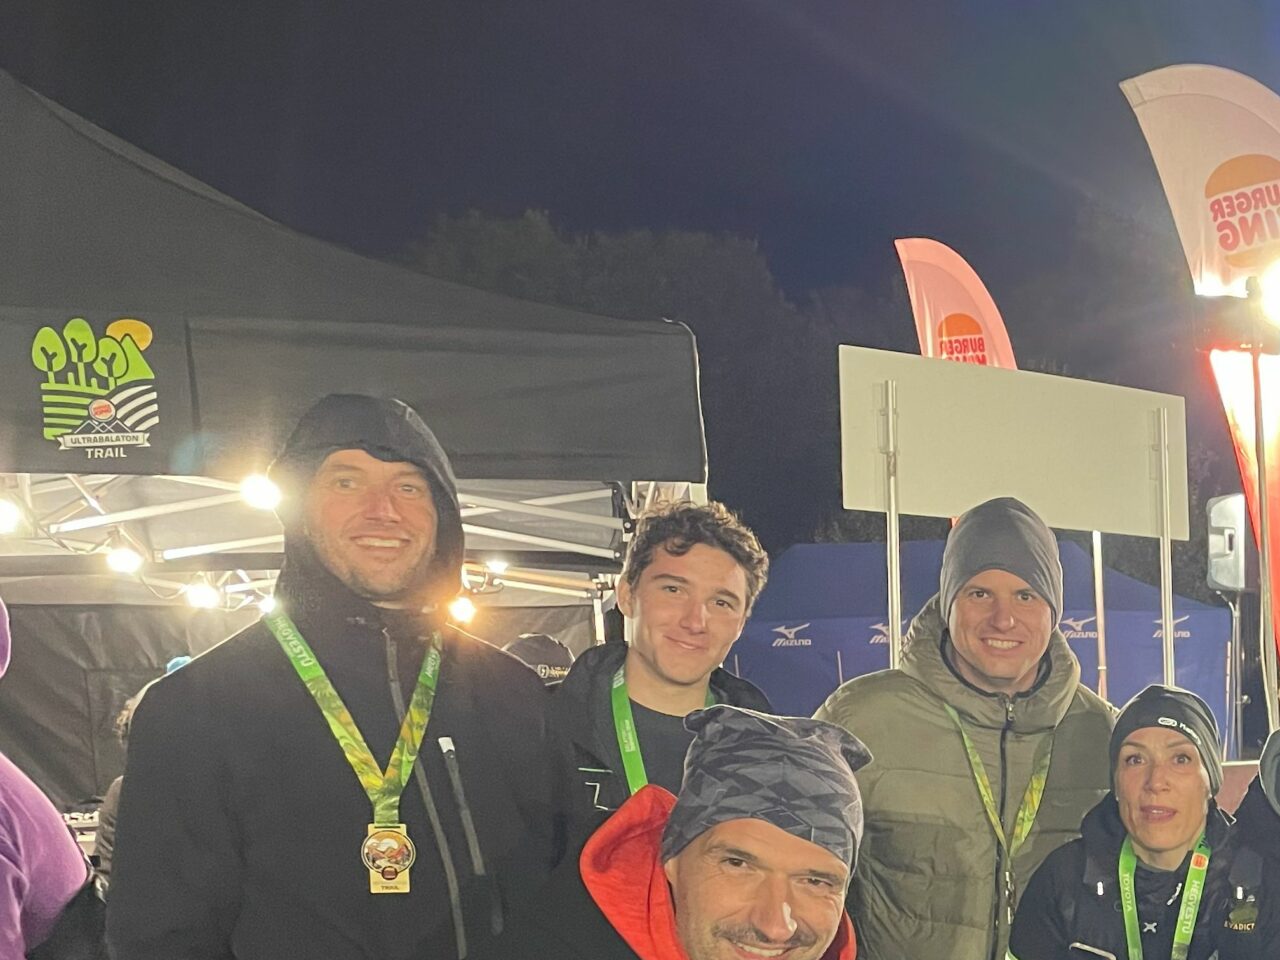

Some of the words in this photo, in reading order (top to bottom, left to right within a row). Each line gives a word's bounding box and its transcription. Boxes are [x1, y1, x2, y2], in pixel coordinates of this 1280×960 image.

[70, 434, 140, 445] ULTRABALATON
[85, 447, 127, 459] TRAIL
[771, 638, 812, 647] MIZUNO
[1122, 872, 1133, 912] TOYOTA
